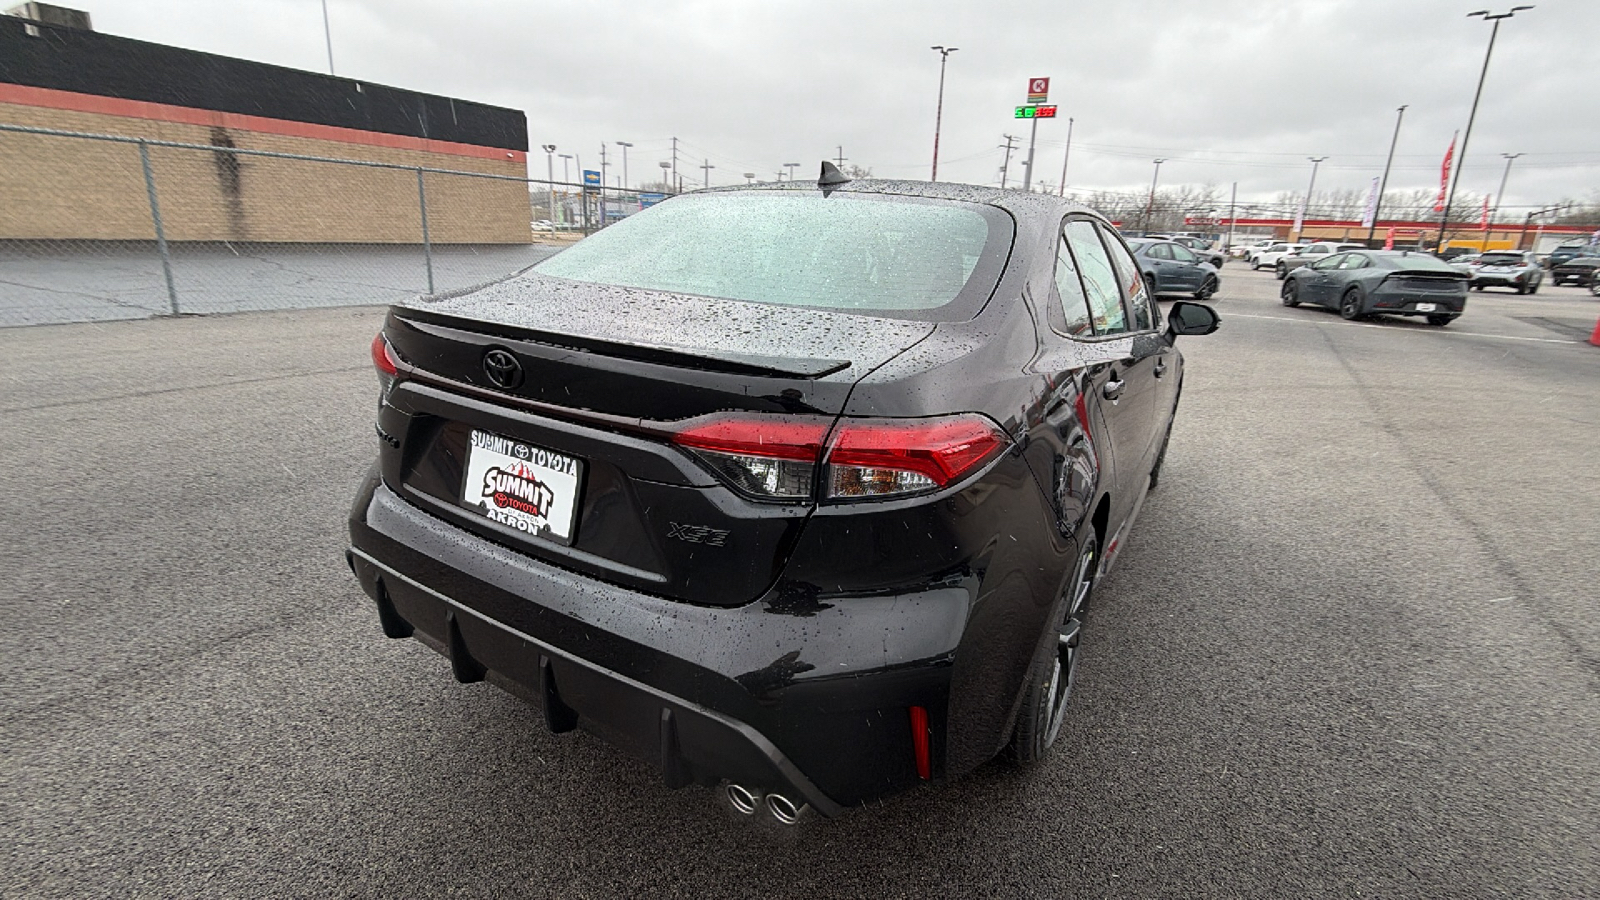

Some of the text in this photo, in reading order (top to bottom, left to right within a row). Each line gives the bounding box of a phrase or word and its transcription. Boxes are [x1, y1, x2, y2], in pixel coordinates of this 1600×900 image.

[471, 430, 577, 477] SUMMIT TOYOTA
[484, 468, 553, 516] SUMMIT
[508, 497, 538, 515] TOYOTA
[487, 508, 539, 536] AKRON
[666, 521, 731, 547] XSE
